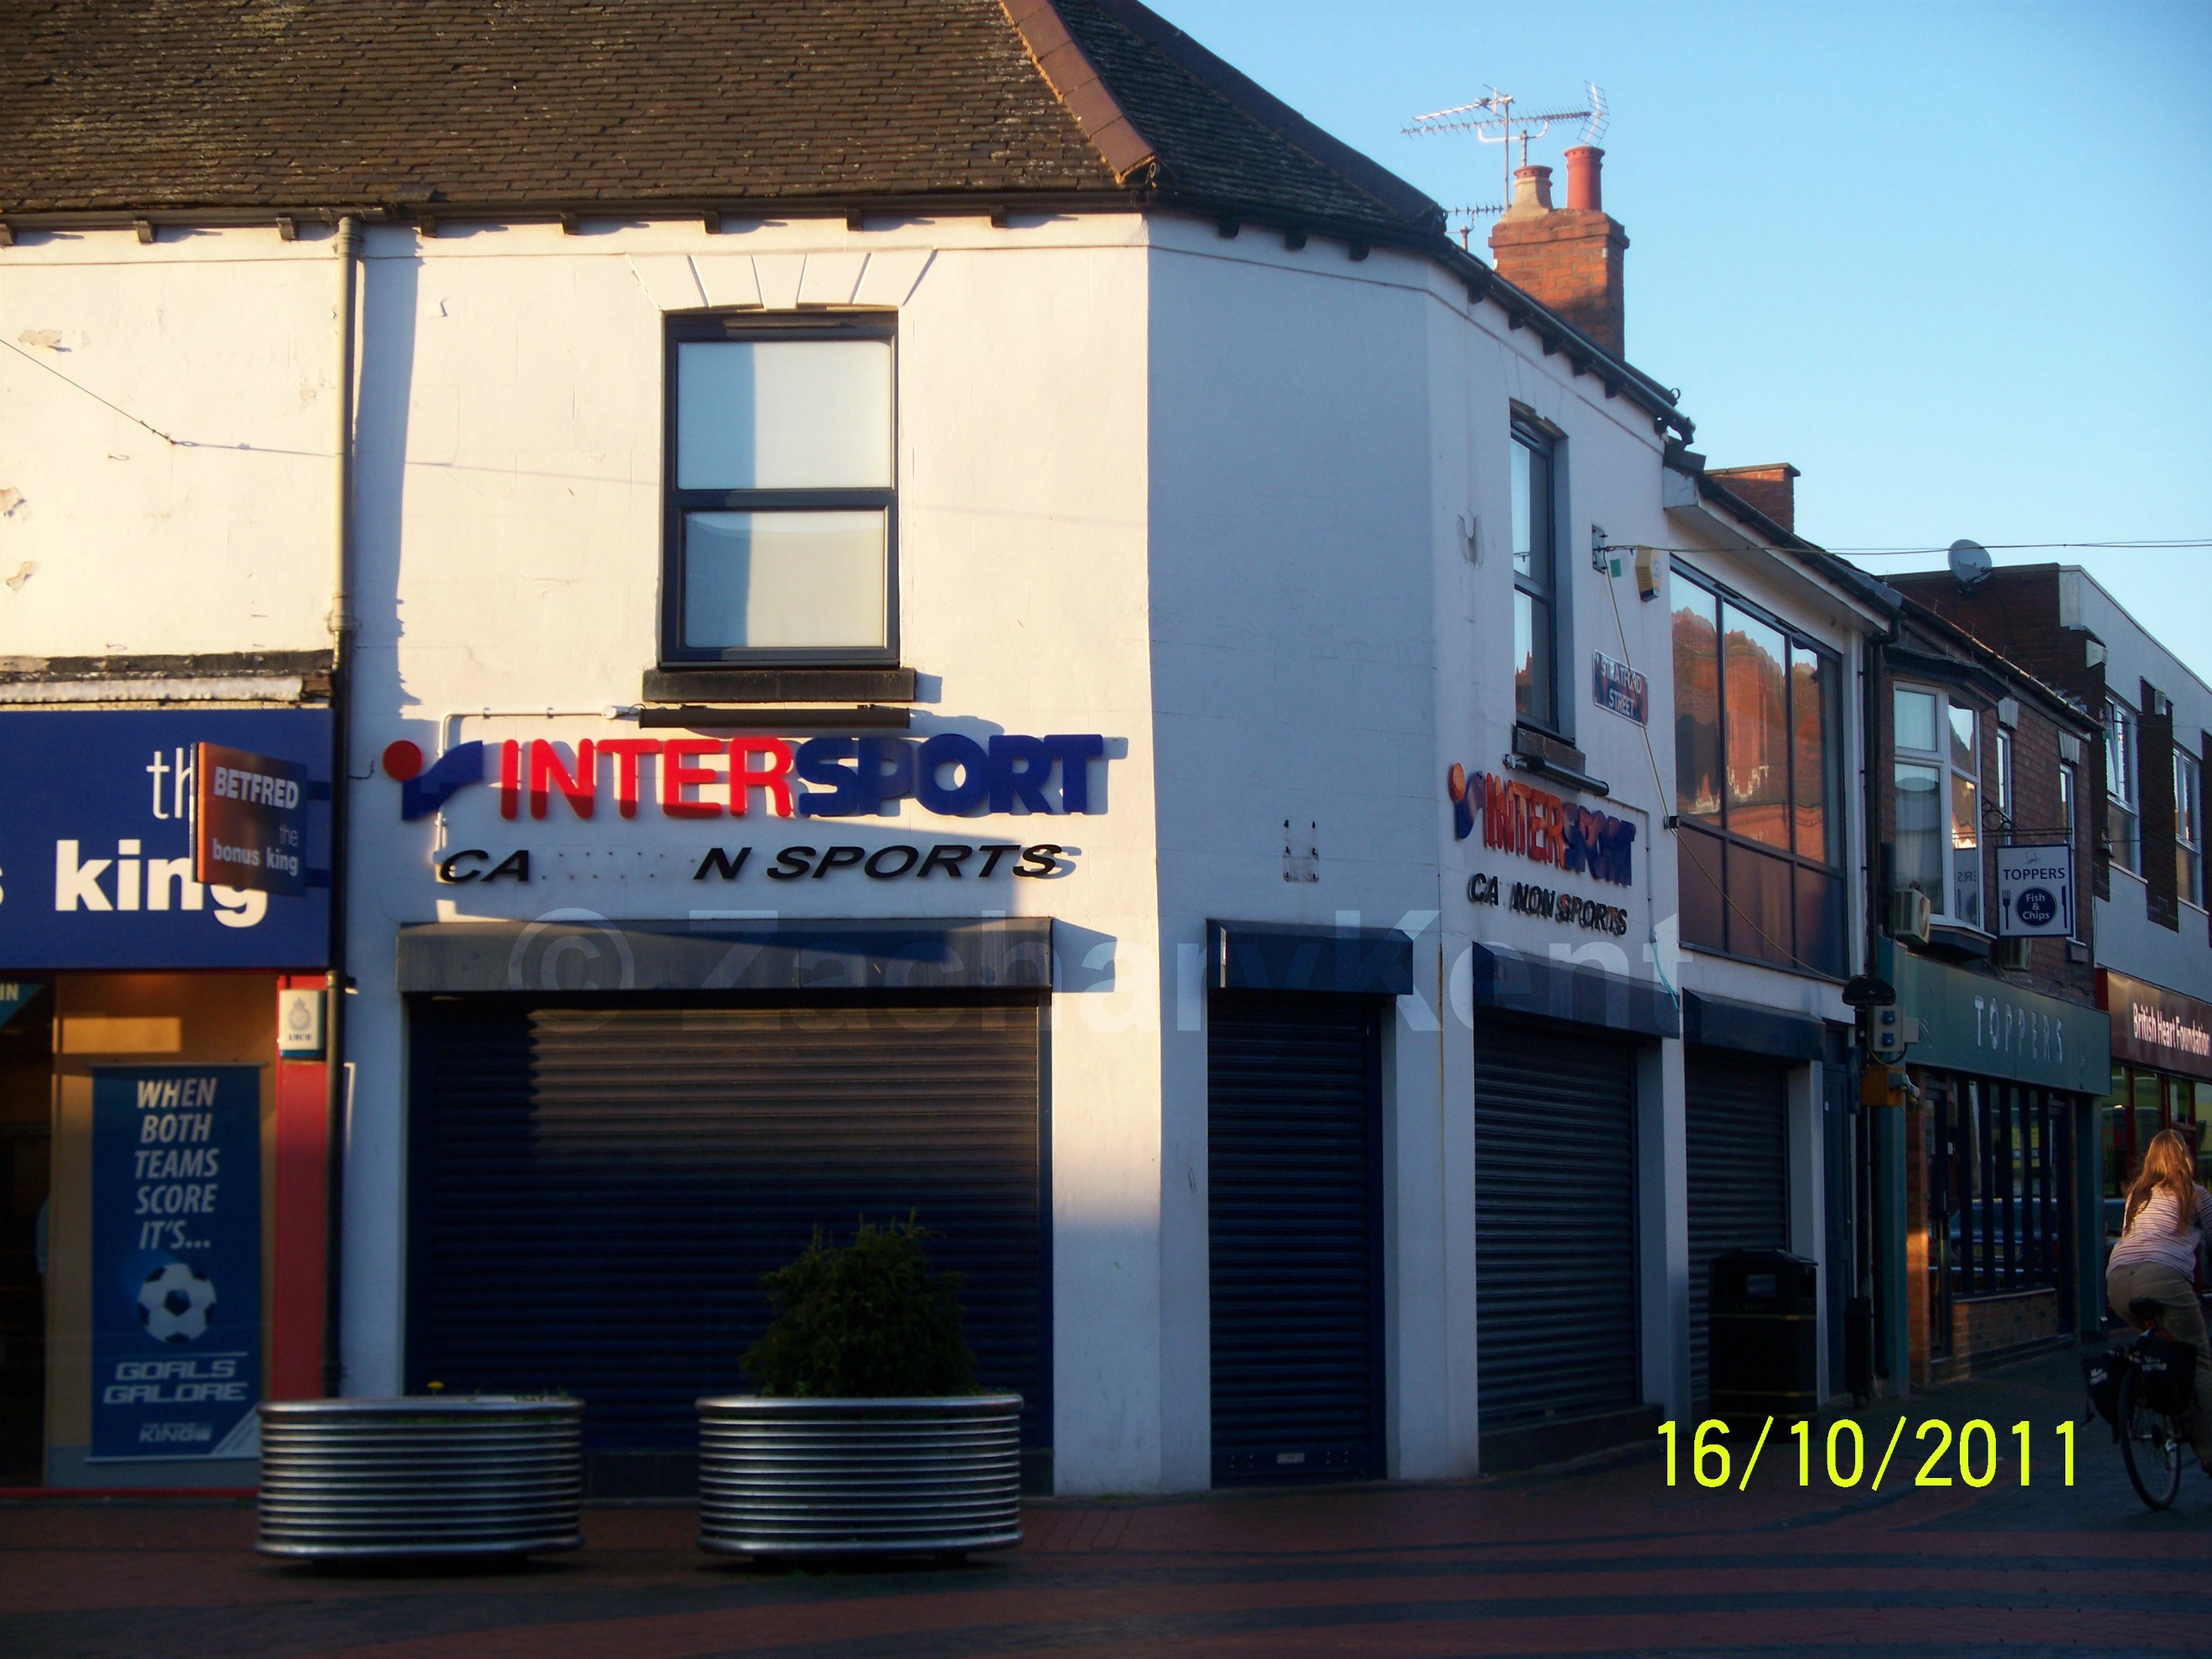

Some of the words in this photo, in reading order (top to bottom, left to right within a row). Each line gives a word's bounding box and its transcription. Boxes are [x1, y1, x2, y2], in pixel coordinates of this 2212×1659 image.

[1601, 655, 1642, 694] STRATFORD
[1609, 688, 1634, 717] STREET
[146, 747, 192, 819] th
[213, 766, 299, 809] BETFRED
[500, 732, 1105, 819] INTERSPORT
[280, 824, 298, 847] the
[1483, 772, 1637, 886] INTERSPORT
[212, 838, 260, 866] bonus
[266, 846, 298, 876] king
[766, 844, 1065, 881] SPORTS
[2003, 867, 2065, 881] TOPPERS
[2026, 893, 2045, 902] Fish
[2032, 902, 2040, 911] &
[1557, 893, 1629, 936] SPORTS
[2022, 911, 2050, 921] Chips
[1974, 995, 2063, 1064] TOPPERS
[2132, 1002, 2157, 1044] British
[2157, 1009, 2177, 1049] Heart
[137, 1078, 217, 1109] WHEN
[139, 1113, 213, 1144] BOTH
[134, 1148, 220, 1179] TEAMS
[134, 1184, 218, 1215] SCORE
[115, 1359, 237, 1381] GOALS
[103, 1382, 249, 1404] GALORE
